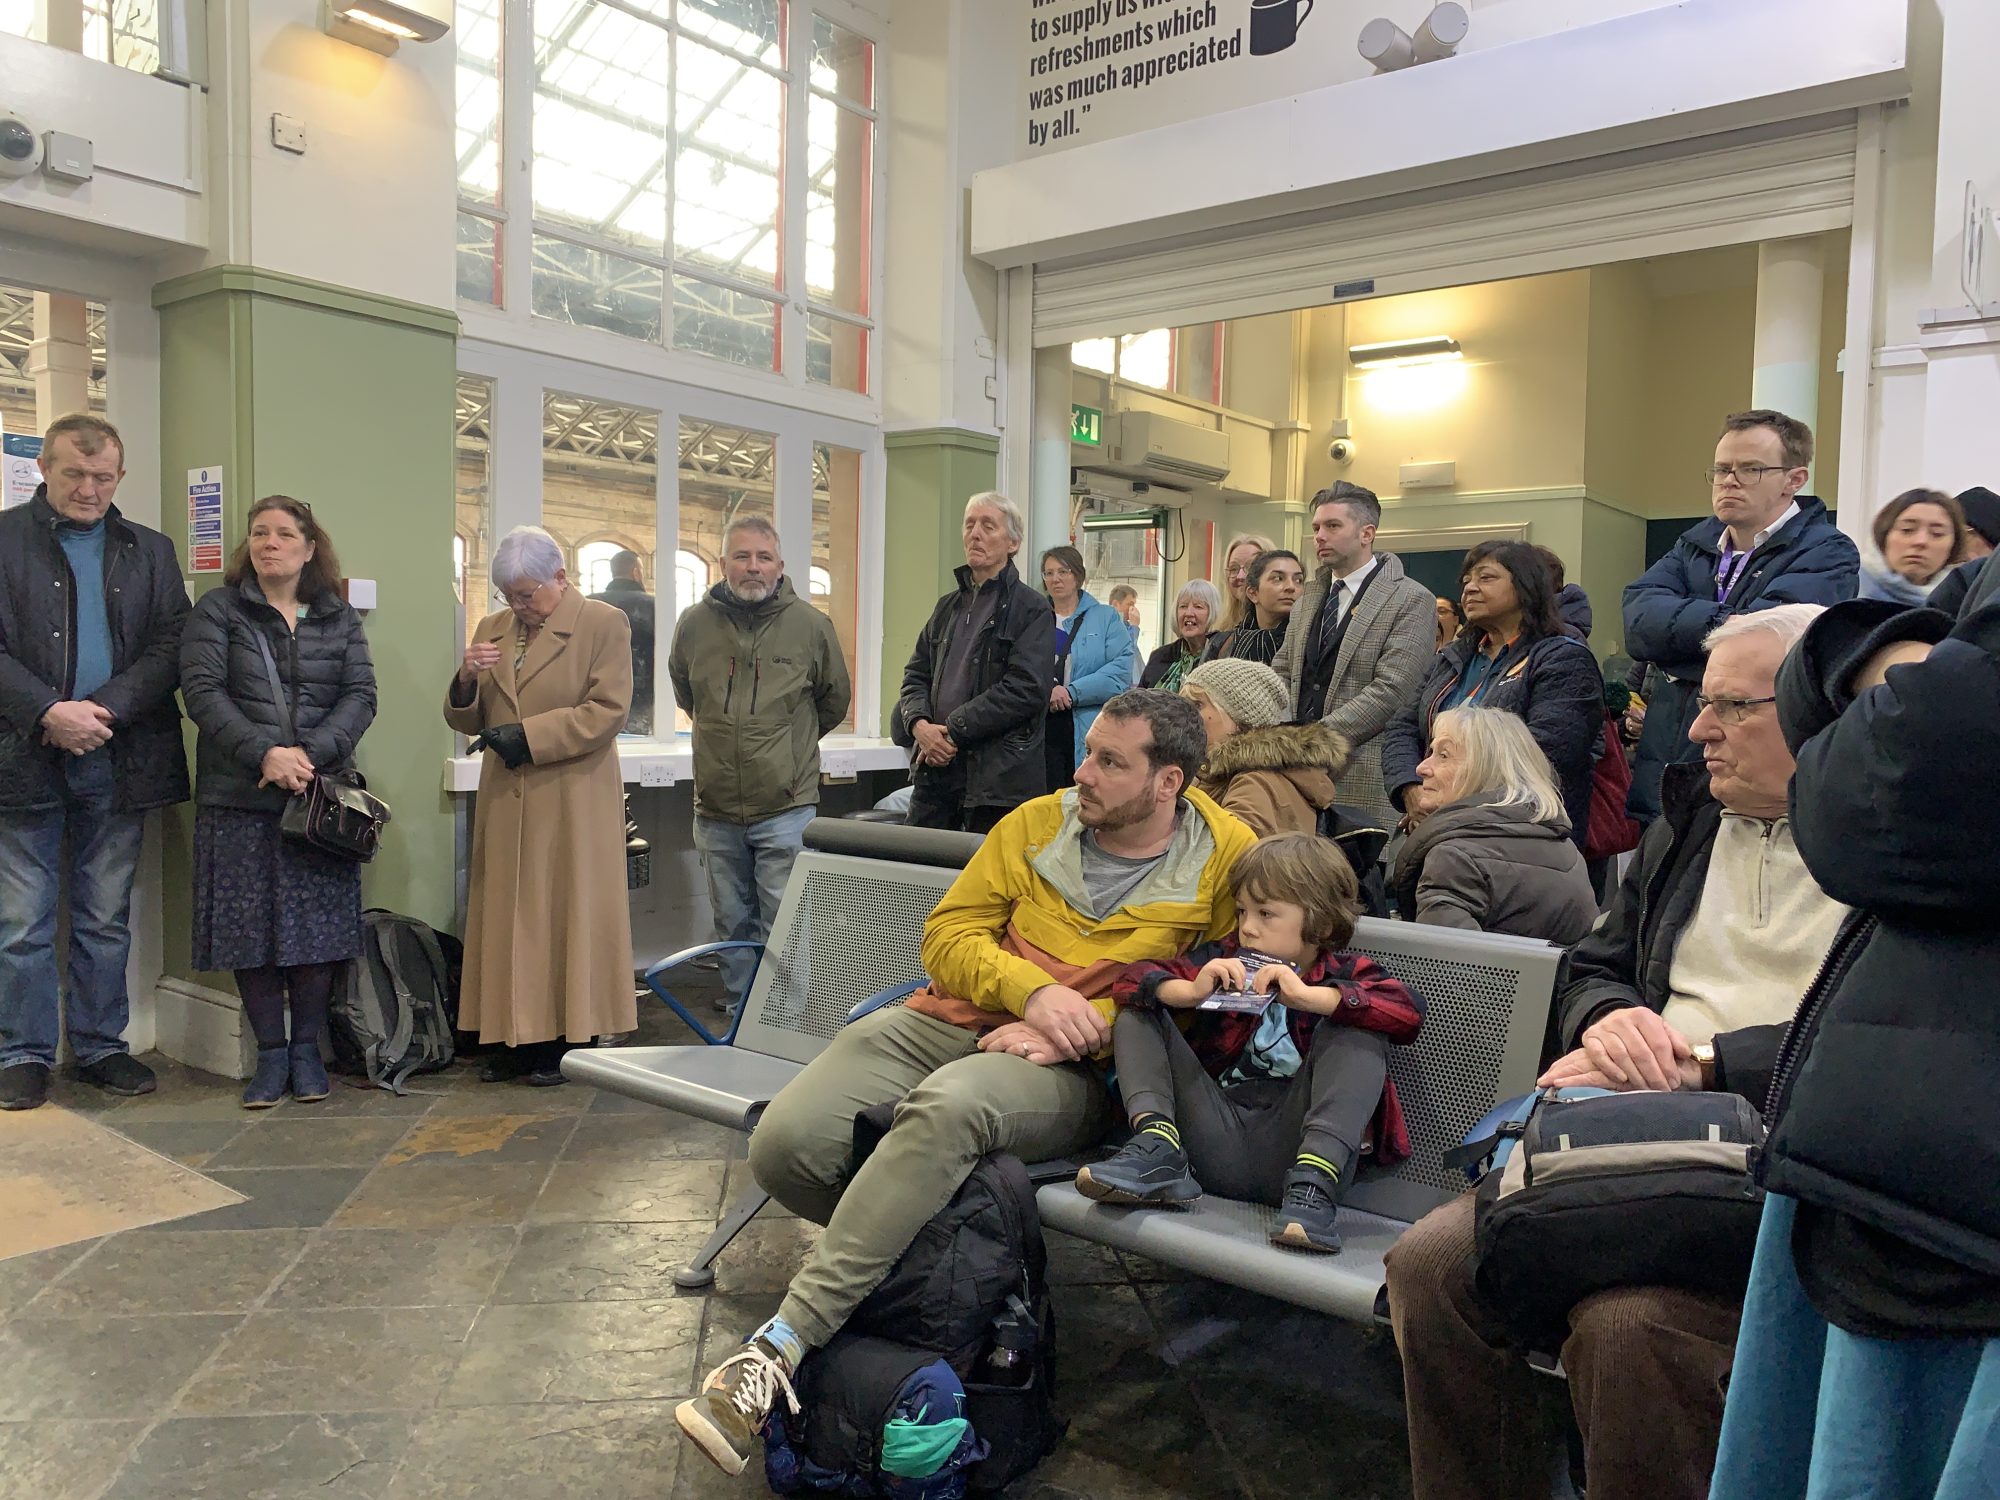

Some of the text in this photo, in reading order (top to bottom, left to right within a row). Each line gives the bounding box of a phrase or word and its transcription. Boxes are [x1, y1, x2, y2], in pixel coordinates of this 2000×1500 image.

[1030, 18, 1048, 42] to
[1051, 0, 1112, 37] supply
[1115, 0, 1138, 18] us
[1030, 1, 1217, 77] refreshments which
[1029, 28, 1242, 111] was much appreciated
[1028, 119, 1049, 147] by
[193, 485, 217, 494] Fire Action
[1727, 572, 1741, 590] LIVE
